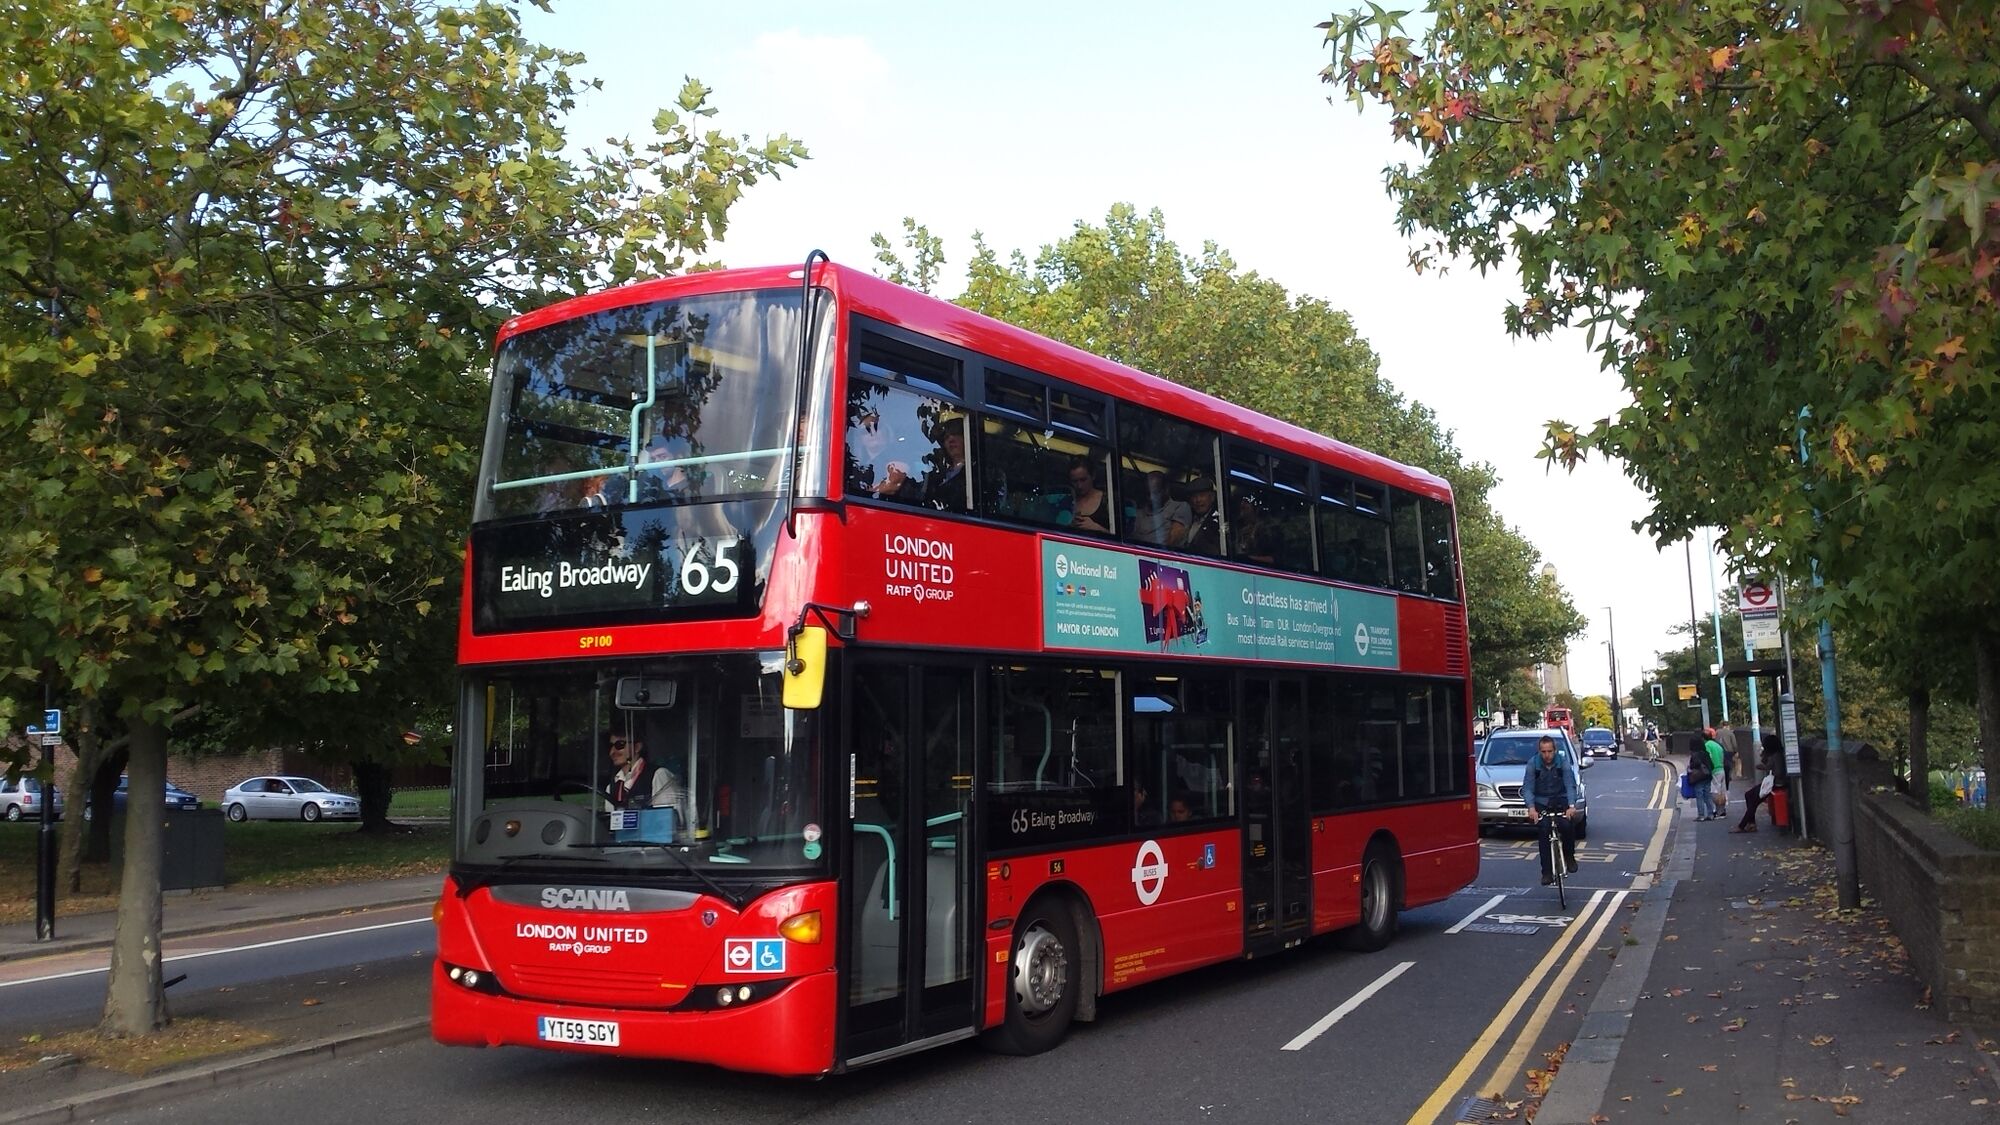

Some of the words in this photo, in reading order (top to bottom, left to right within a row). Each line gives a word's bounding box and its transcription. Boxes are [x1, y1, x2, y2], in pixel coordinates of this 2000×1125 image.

[885, 534, 953, 561] LONDON
[501, 565, 553, 598] Ealing
[559, 558, 652, 590] Broadway
[681, 540, 740, 596] 65
[886, 558, 954, 584] UNITED
[1070, 560, 1102, 578] National
[1103, 565, 1117, 580] Rail
[886, 584, 912, 597] RATP
[925, 588, 954, 601] GROUP
[1241, 588, 1288, 609] Contactless
[1289, 595, 1303, 611] has
[1304, 598, 1327, 614] arrived
[1056, 622, 1081, 635] MAYOR
[1081, 625, 1091, 636] OF
[1092, 626, 1119, 637] LONDON
[1227, 613, 1239, 626] Bus
[1242, 615, 1256, 628] Tube
[1260, 616, 1275, 629] Tram
[1278, 619, 1289, 631] DLR
[1292, 619, 1312, 633] London
[579, 635, 613, 649] SP100
[1315, 640, 1335, 651] London
[1011, 809, 1028, 834] 65
[1031, 811, 1056, 830] Ealing
[1058, 808, 1096, 825] Broadway
[1143, 868, 1157, 878] BUSES
[541, 887, 631, 911] SCANIA
[516, 923, 577, 940] LONDON
[584, 927, 648, 943] UNITED
[549, 942, 572, 953] RATP
[584, 945, 612, 954] GROUP
[548, 1019, 584, 1040] YT59
[588, 1023, 616, 1043] SGY
